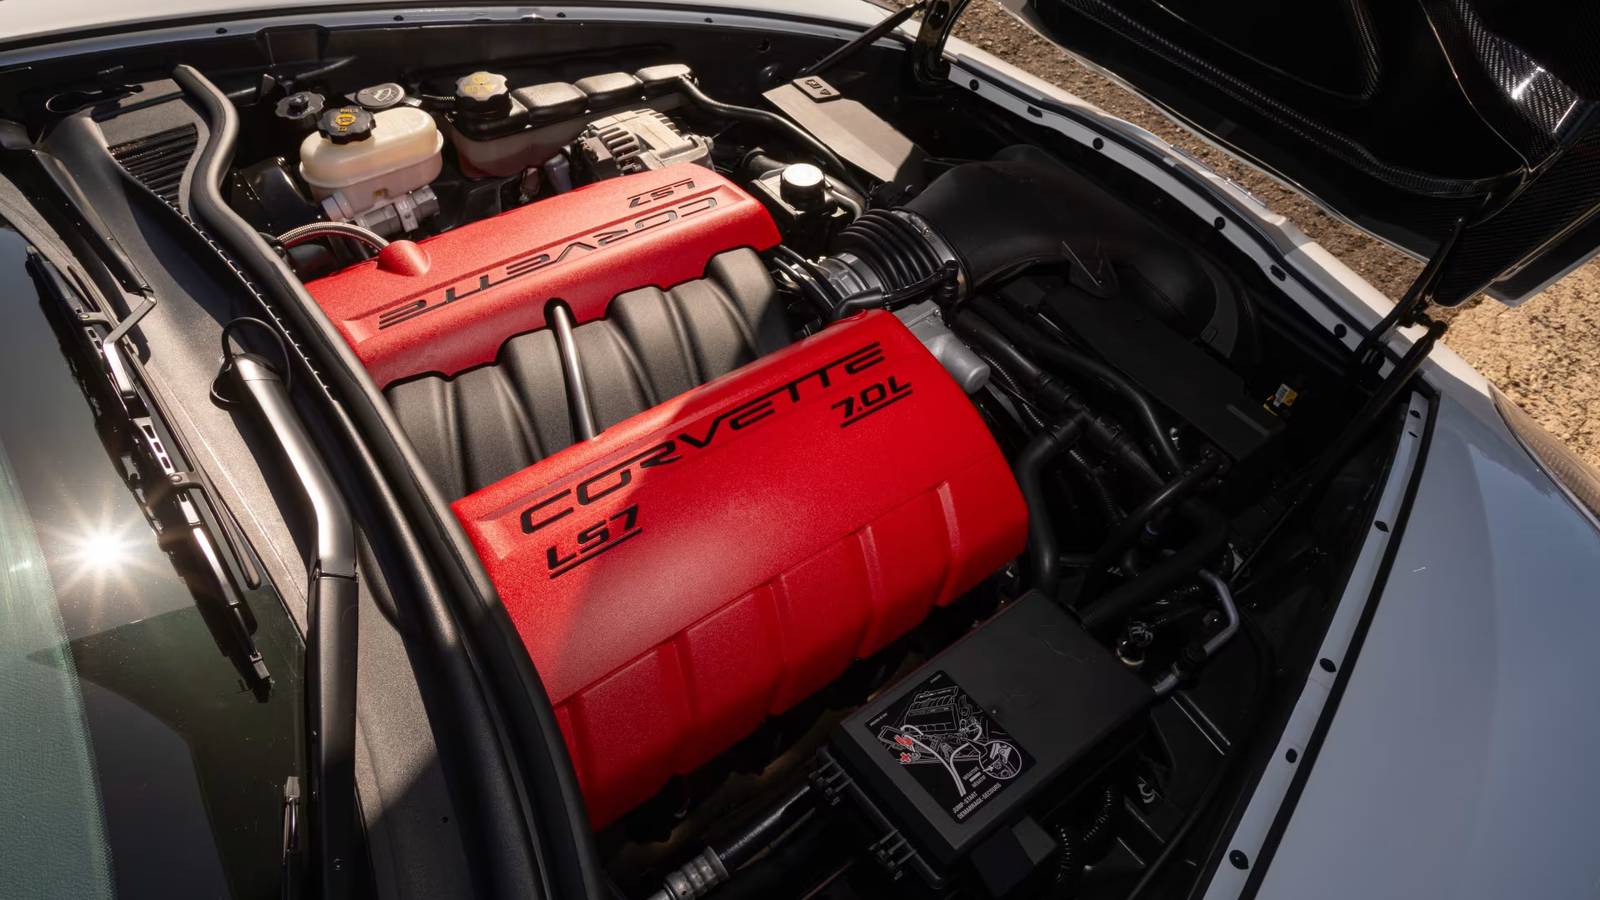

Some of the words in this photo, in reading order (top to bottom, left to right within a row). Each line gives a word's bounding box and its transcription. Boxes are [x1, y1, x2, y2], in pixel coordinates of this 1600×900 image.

[629, 180, 696, 209] LS7
[379, 196, 718, 330] CORVETTE
[831, 375, 912, 420] 7.0L
[519, 341, 885, 535] CORVETTE
[545, 503, 641, 571] LS7
